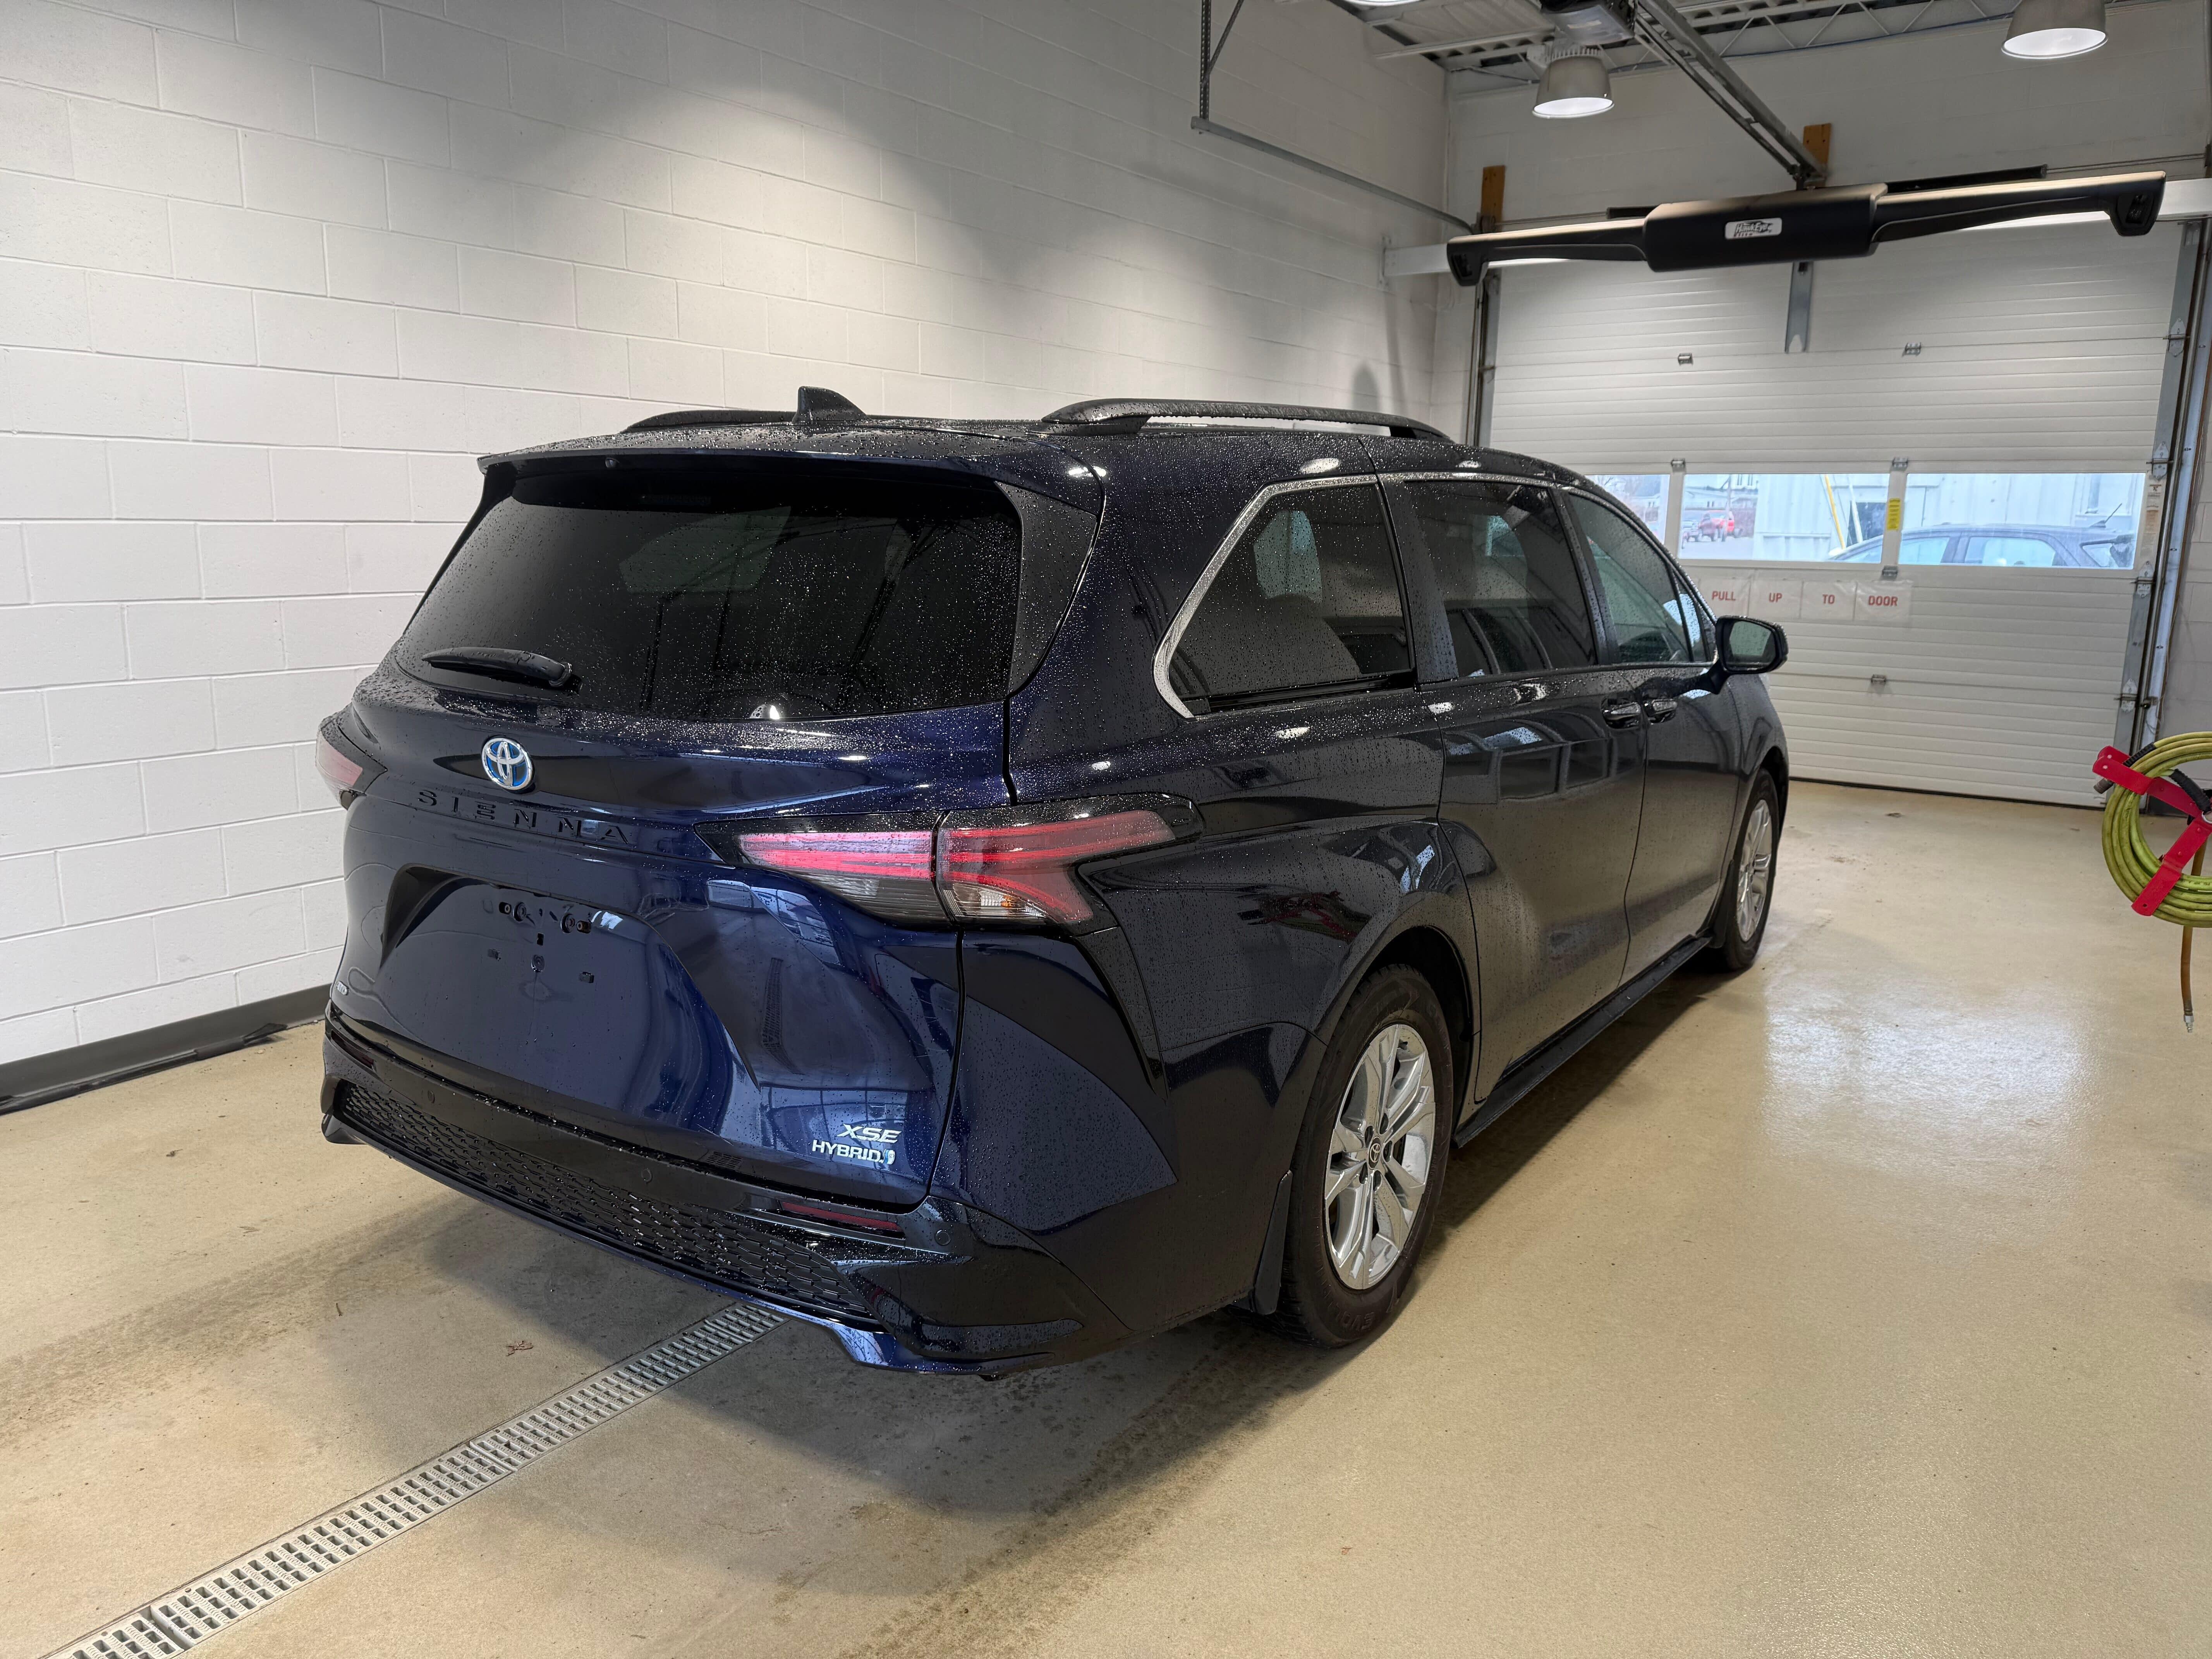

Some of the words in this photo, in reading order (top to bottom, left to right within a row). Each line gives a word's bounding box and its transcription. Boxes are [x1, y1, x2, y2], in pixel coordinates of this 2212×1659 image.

[1712, 591, 1736, 601] PULL
[1769, 592, 1783, 603] UP
[1822, 594, 1835, 604] TO
[1868, 596, 1898, 606] DOOR
[418, 790, 629, 844] SIENNA
[837, 1123, 902, 1144] XSE
[812, 1140, 882, 1163] HYBRID
